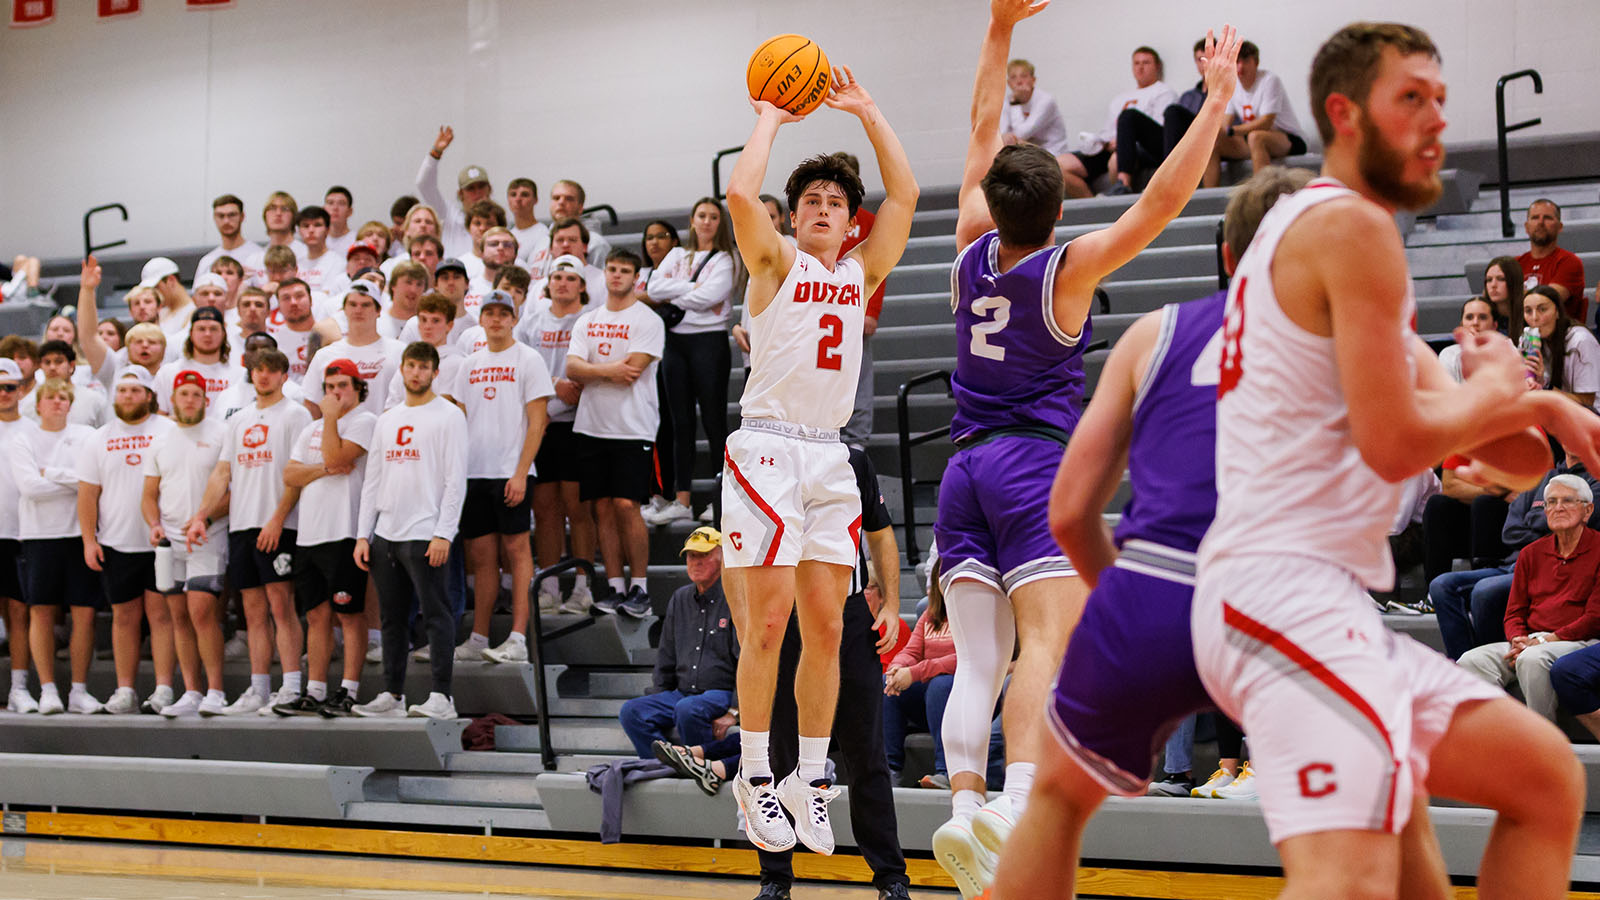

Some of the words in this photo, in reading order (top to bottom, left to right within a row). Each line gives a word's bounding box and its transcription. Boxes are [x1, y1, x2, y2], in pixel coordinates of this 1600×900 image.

[777, 65, 802, 96] EVO
[793, 281, 861, 307] DUTCH
[816, 313, 843, 370] 2
[970, 296, 1011, 361] 2
[396, 425, 414, 446] C
[385, 449, 420, 458] CENRAL
[729, 531, 742, 551] C
[1298, 762, 1337, 798] C
